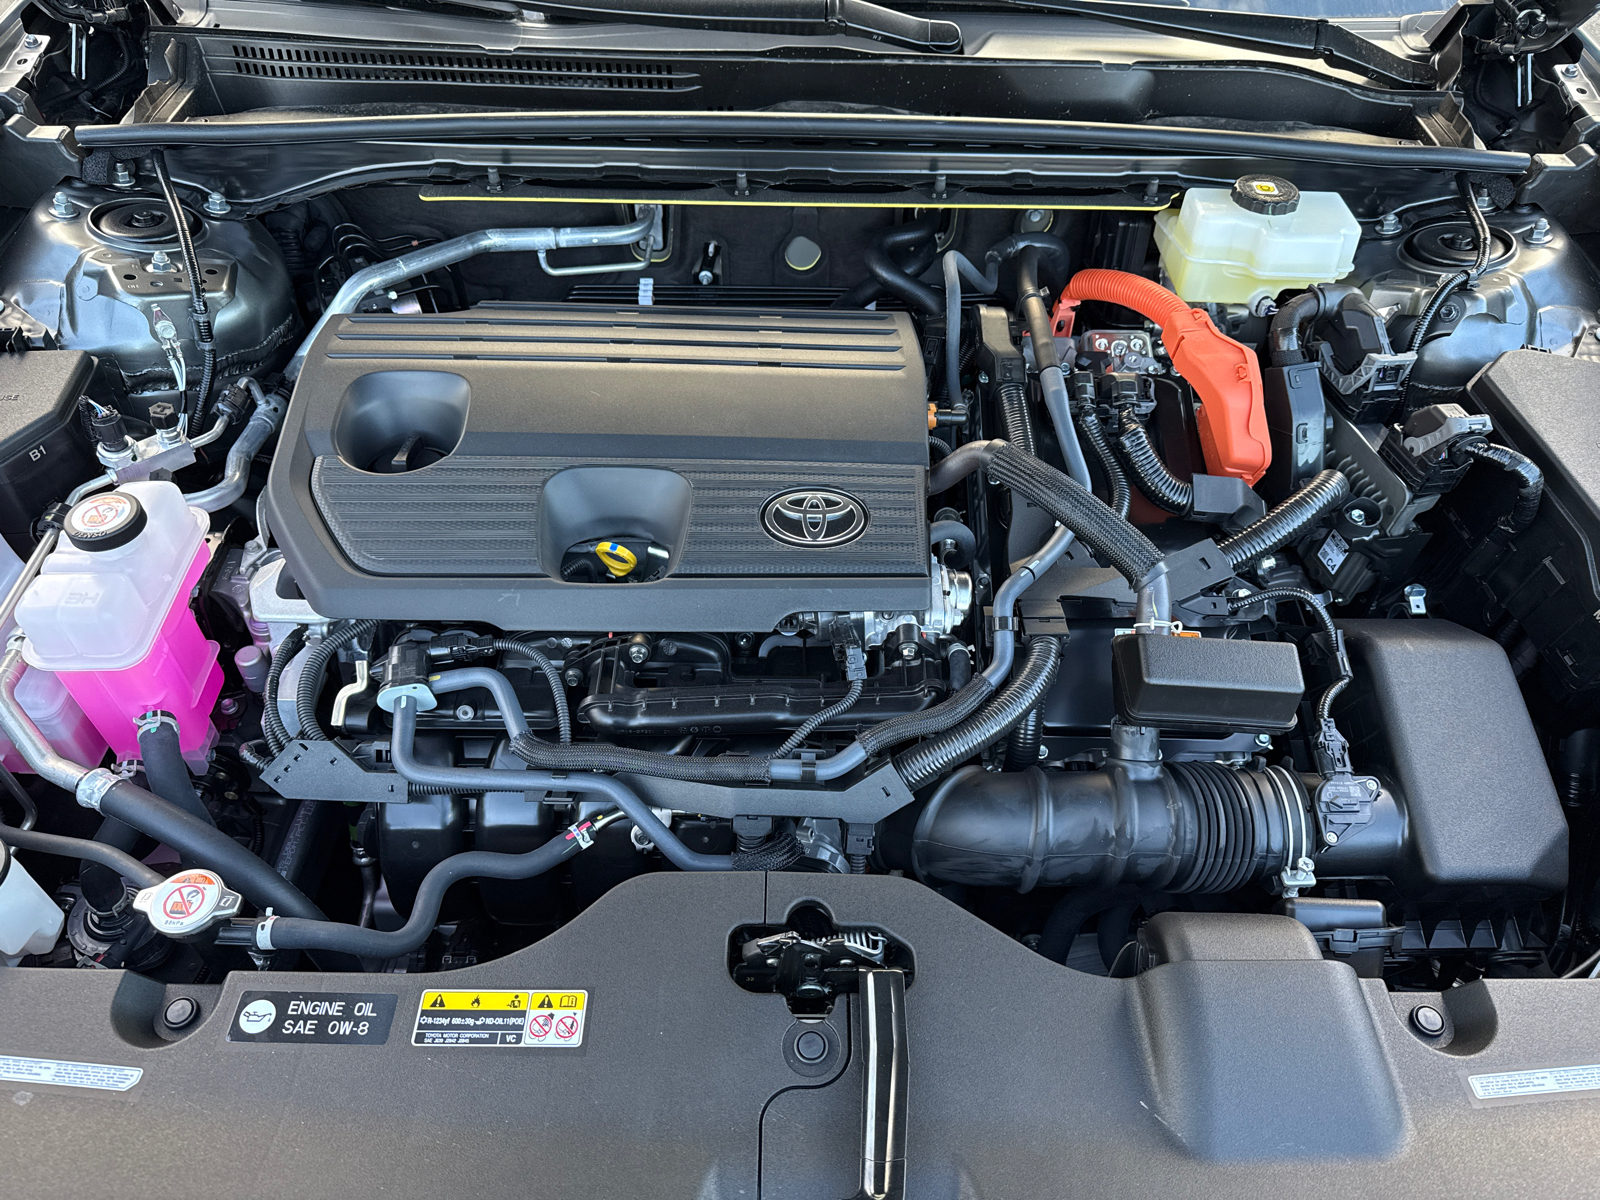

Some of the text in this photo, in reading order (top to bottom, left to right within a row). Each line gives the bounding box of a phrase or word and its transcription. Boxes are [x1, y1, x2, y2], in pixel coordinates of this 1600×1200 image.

[28, 444, 47, 462] B1
[287, 1000, 378, 1017] ENGINE OIL
[281, 1019, 370, 1036] SAE 0W-8
[427, 1016, 450, 1026] R-1234yf
[505, 1034, 517, 1043] VC
